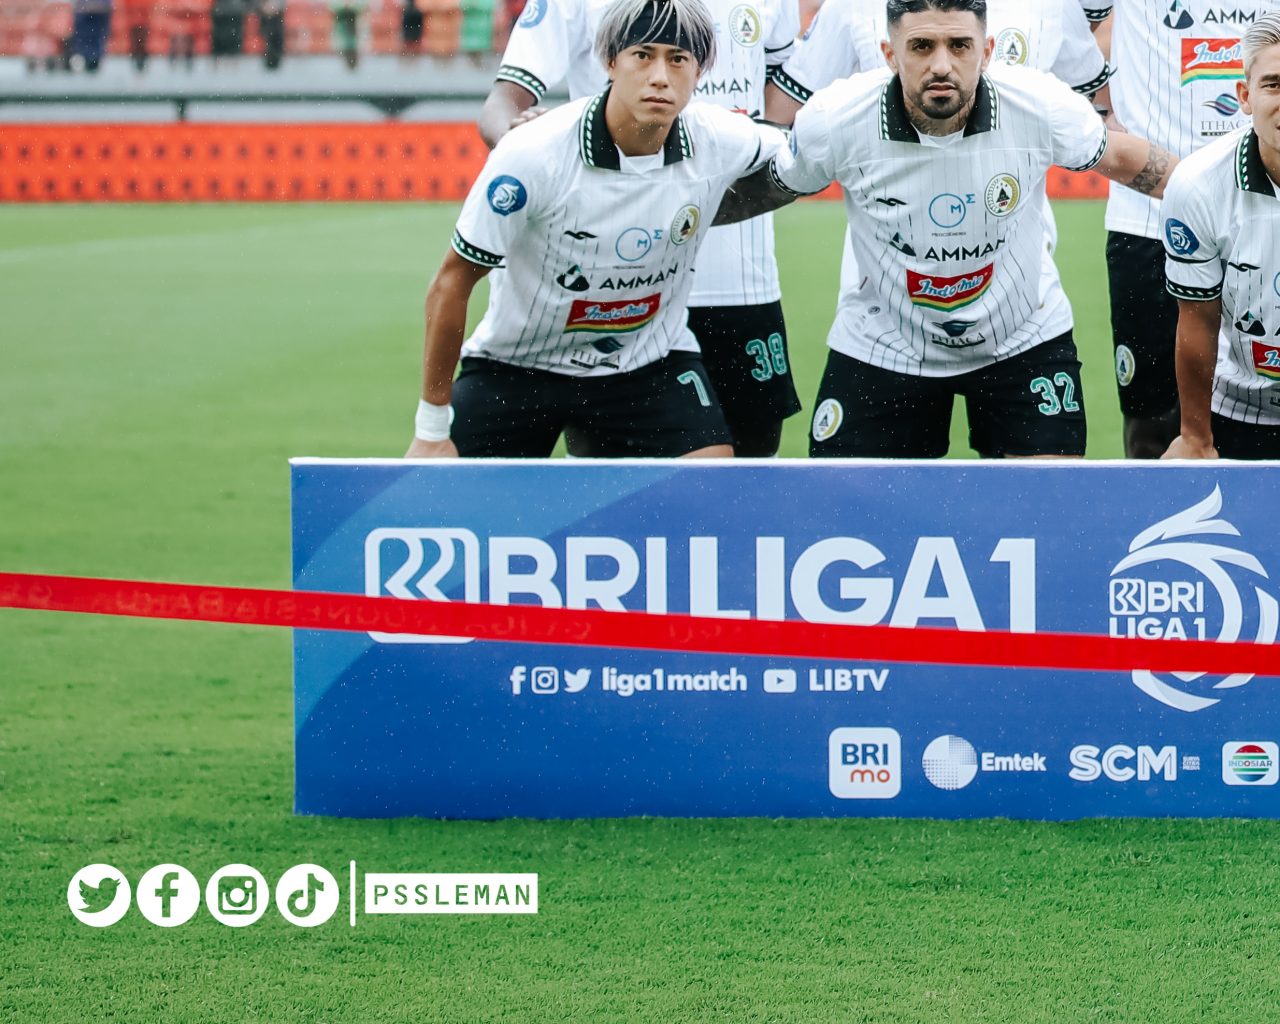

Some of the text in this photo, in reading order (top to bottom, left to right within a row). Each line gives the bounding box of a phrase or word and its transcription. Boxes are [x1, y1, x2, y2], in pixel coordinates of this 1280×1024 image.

[1203, 8, 1256, 24] AMM
[1201, 120, 1246, 131] ITHAC
[925, 236, 1005, 261] AMMAN
[598, 263, 678, 290] AMMAN
[745, 332, 787, 381] 38
[676, 370, 711, 406] 7
[1030, 372, 1080, 416] 32
[489, 537, 667, 615] BRI
[1148, 581, 1204, 613] BRI
[1109, 617, 1188, 640] LIGA
[602, 667, 748, 697] liga1match
[809, 668, 890, 692] LIBTV
[841, 743, 888, 765] BRI
[981, 752, 1047, 771] Emtek
[1069, 744, 1177, 782] SCM
[1228, 759, 1273, 768] INDOSIAR
[850, 769, 890, 783] mo
